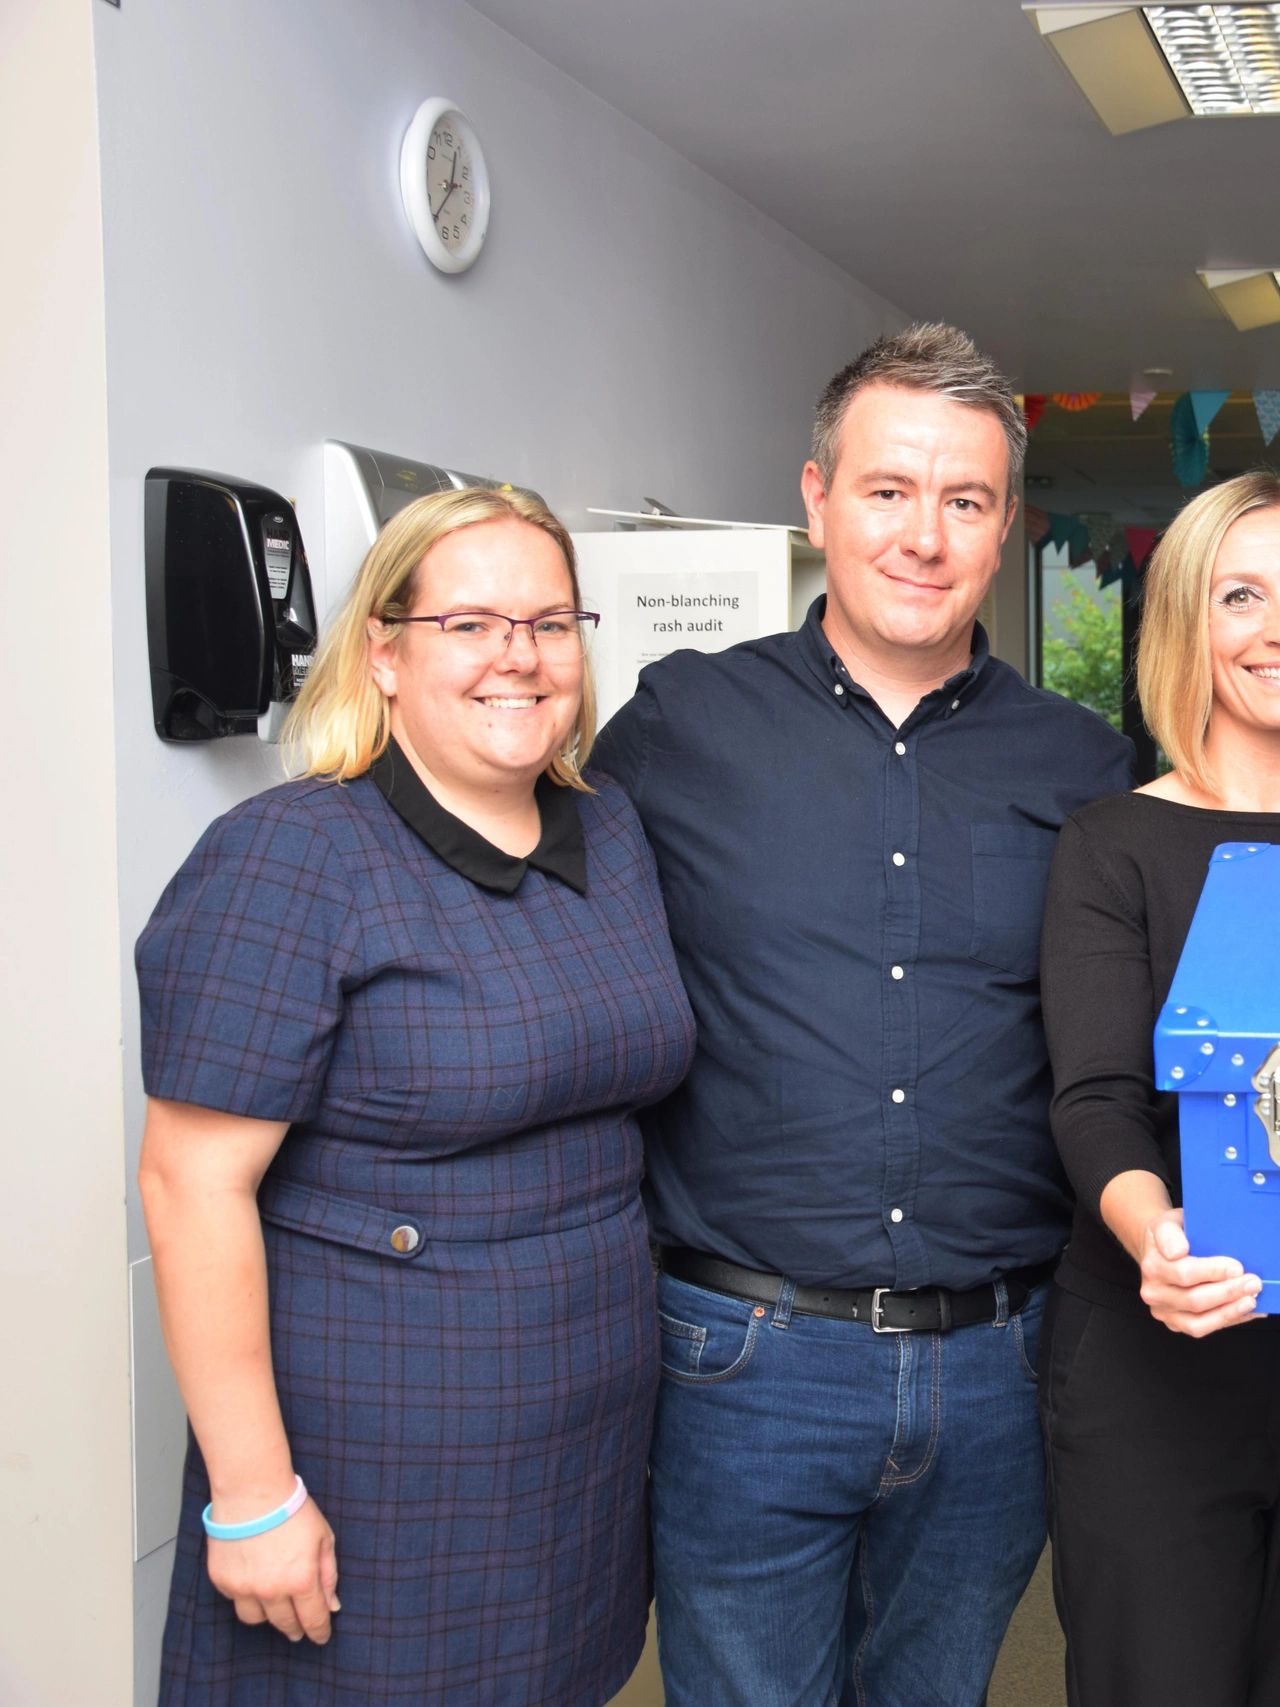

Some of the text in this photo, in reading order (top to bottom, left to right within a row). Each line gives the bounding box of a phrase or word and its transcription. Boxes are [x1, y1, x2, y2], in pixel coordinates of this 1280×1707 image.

[443, 131, 454, 147] 12
[462, 165, 469, 181] 2
[464, 191, 470, 205] 3
[461, 214, 467, 225] 4
[442, 226, 449, 240] 6
[453, 225, 459, 239] 5
[266, 538, 290, 550] MEDIC
[637, 594, 740, 609] Non-blanching
[653, 619, 724, 632] rash audit
